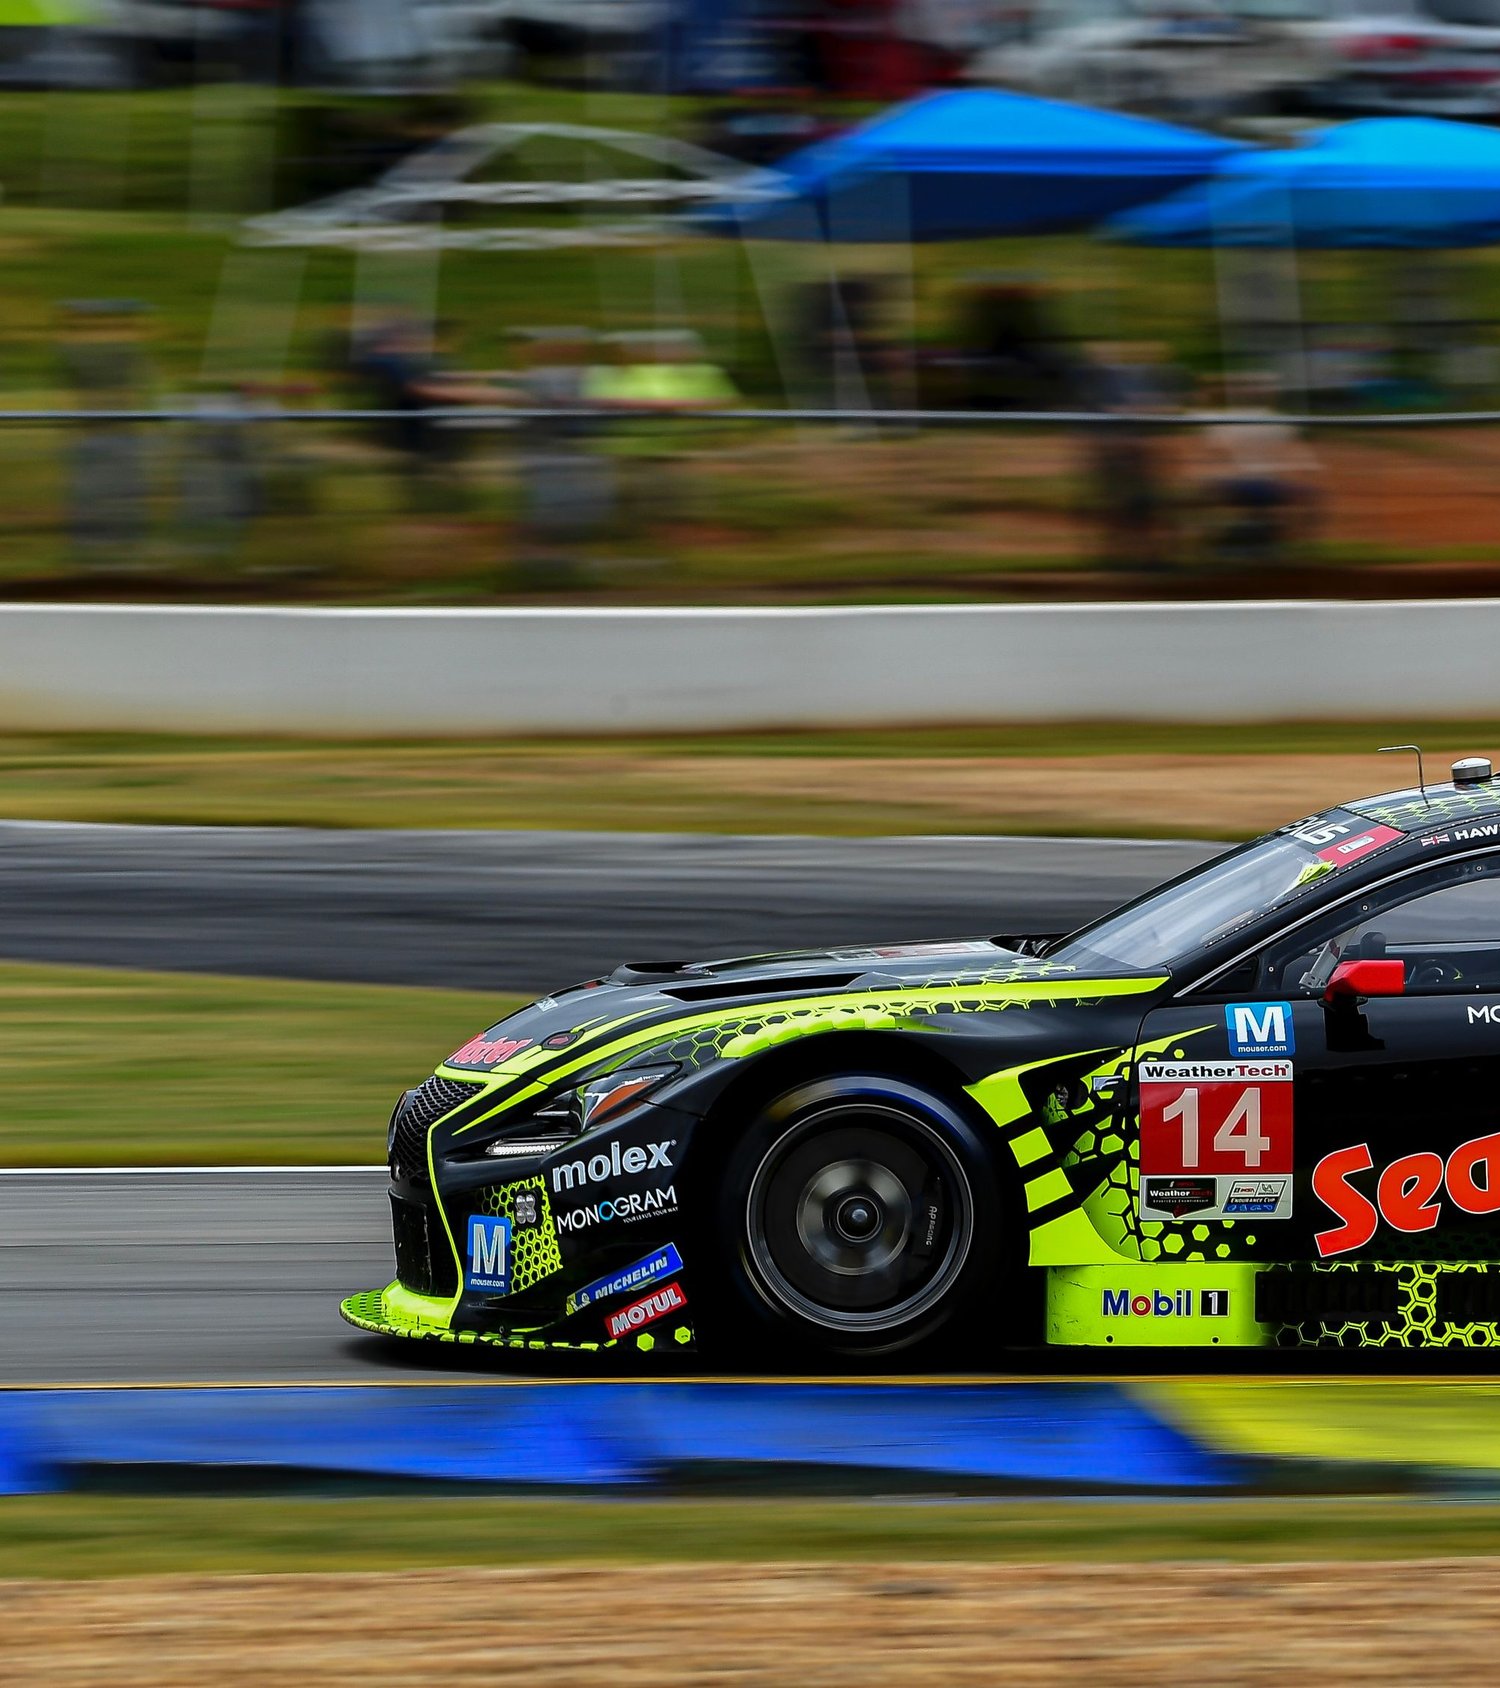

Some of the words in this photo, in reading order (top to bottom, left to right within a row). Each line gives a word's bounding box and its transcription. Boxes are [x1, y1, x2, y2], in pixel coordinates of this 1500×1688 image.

[1234, 1006, 1287, 1043] M
[1145, 1064, 1289, 1078] WeatherTech
[1238, 1045, 1287, 1053] mouser.com
[1162, 1086, 1271, 1168] 14
[552, 1141, 673, 1193] molex
[557, 1185, 678, 1235] MONOGRAM
[472, 1223, 506, 1276] M
[470, 1278, 505, 1288] mouser.com
[594, 1256, 668, 1300] MICHELIN
[611, 1288, 682, 1336] MOTUL
[1103, 1289, 1192, 1317] Mobil
